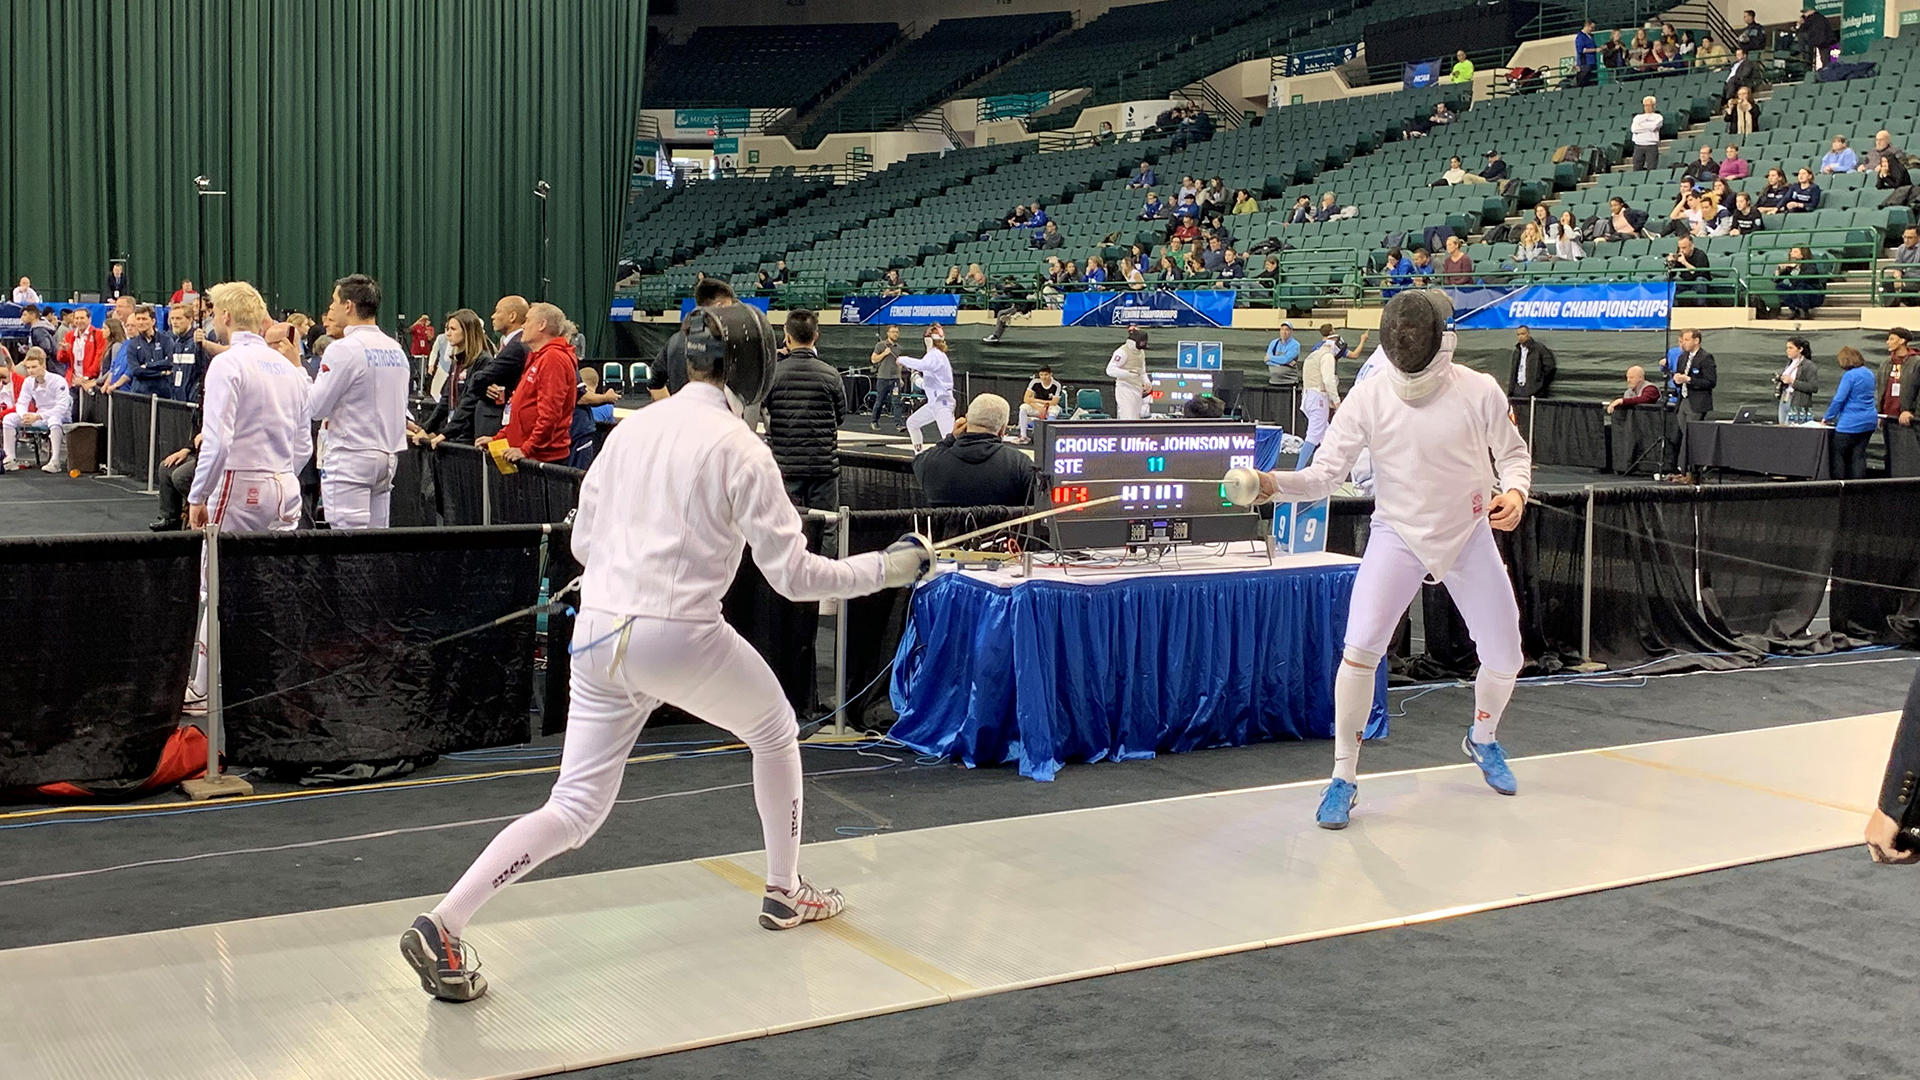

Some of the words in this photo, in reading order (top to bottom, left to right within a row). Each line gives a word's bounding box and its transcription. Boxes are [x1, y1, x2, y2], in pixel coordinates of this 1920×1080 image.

[1413, 74, 1430, 83] NCAA
[889, 306, 913, 317] FENCING
[912, 305, 957, 317] CHAMPIONSHIPS
[1509, 301, 1560, 318] FENCING
[1561, 299, 1668, 318] CHAMPIONSHIPS
[1184, 353, 1193, 364] 3
[1207, 354, 1215, 366] 4
[1055, 437, 1117, 453] CROUSE
[1121, 437, 1158, 452] Ulfric
[1160, 436, 1230, 451] JOHNSON
[1231, 435, 1255, 450] We
[1054, 458, 1084, 474] STE
[1148, 456, 1164, 472] 11
[1278, 515, 1287, 539] 9
[1303, 518, 1318, 542] 9
[1477, 708, 1491, 723] P
